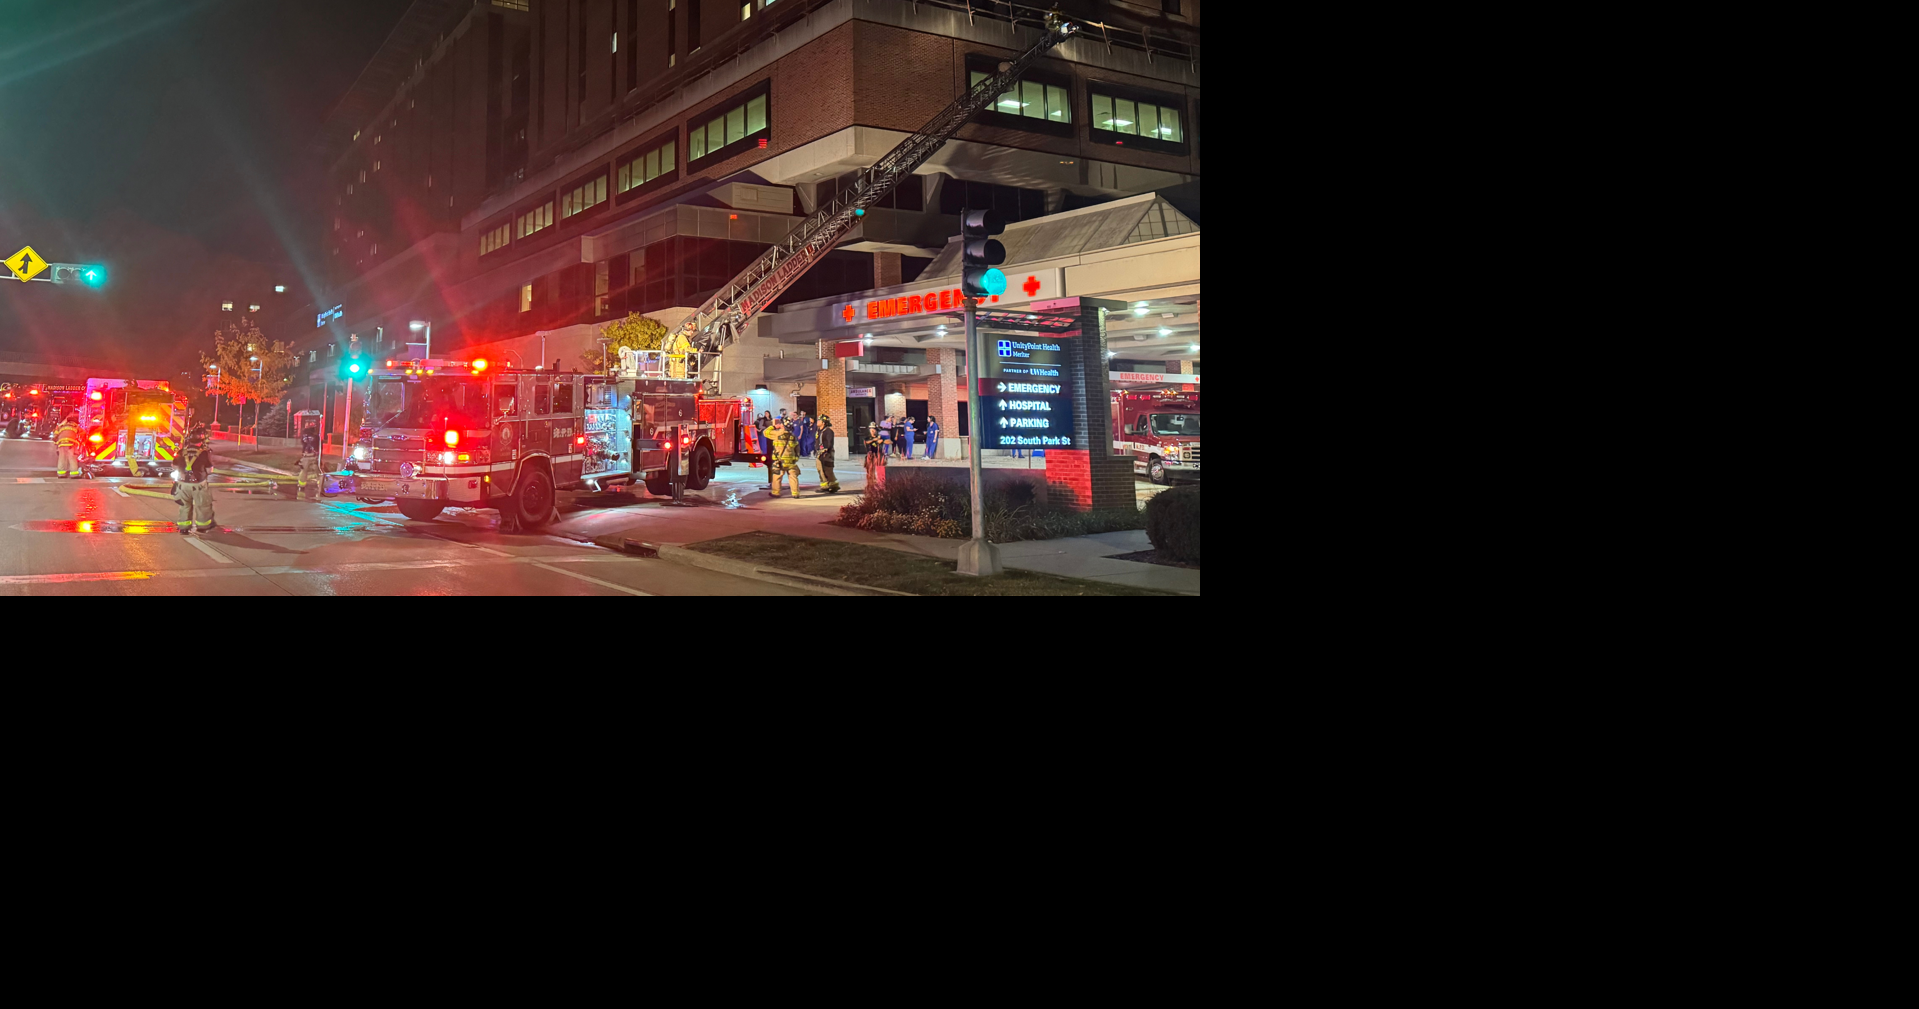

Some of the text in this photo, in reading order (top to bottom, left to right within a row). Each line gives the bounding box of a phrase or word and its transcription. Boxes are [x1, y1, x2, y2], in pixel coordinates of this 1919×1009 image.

[740, 249, 808, 312] MADISON LADDER
[1012, 342, 1061, 352] UnityPoint Health
[1120, 373, 1164, 381] EMERGENCY
[1008, 382, 1061, 394] EMERGENCY
[1009, 400, 1052, 411] HOSPITAL
[1010, 418, 1050, 428] PARKING
[1000, 436, 1071, 446] 202 South Park St
